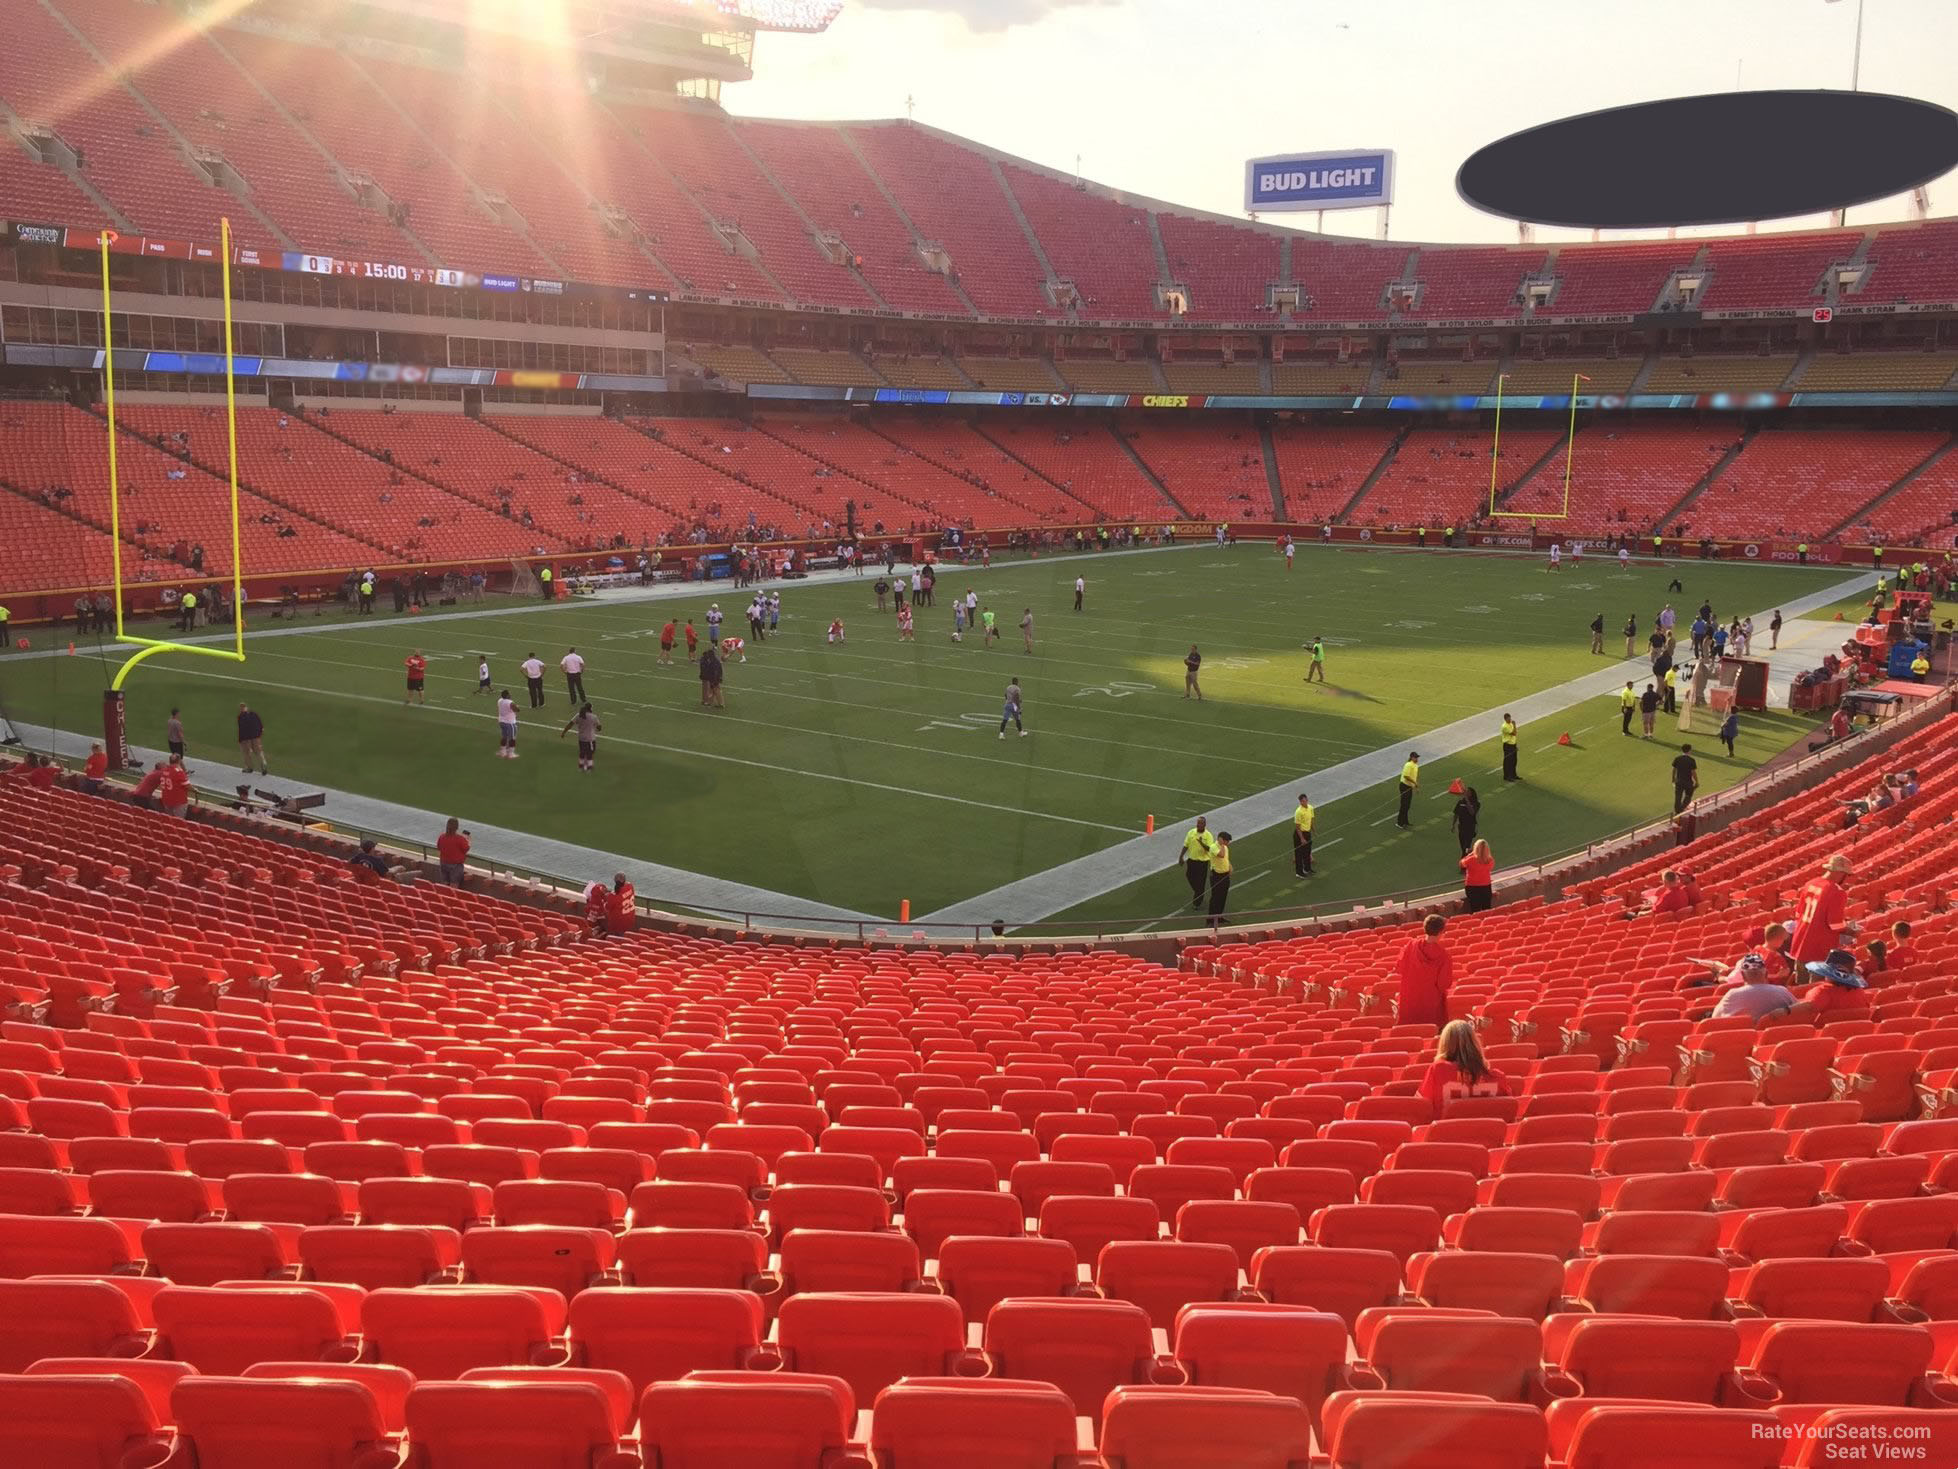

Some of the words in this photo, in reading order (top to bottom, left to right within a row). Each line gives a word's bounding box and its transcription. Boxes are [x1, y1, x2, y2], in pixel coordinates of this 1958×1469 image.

[1260, 172, 1306, 192] BUD
[1309, 167, 1376, 189] LIGHT
[310, 257, 318, 271] 0
[364, 262, 407, 280] 15:00
[1814, 310, 1830, 320] 25
[1142, 395, 1189, 408] CHIEFS
[116, 700, 129, 769] CHIEFS
